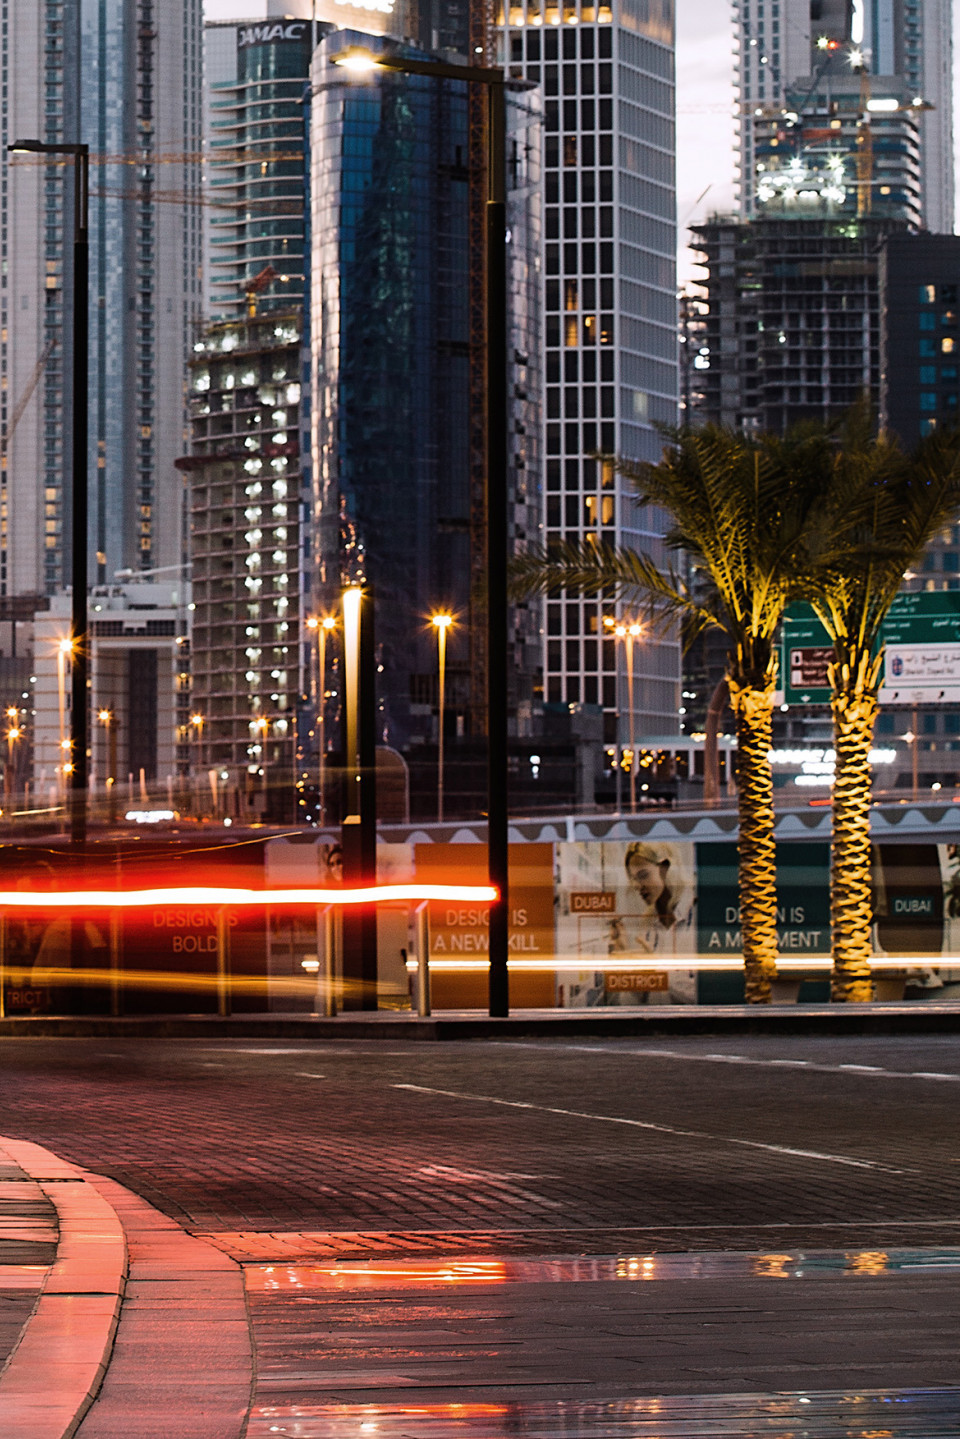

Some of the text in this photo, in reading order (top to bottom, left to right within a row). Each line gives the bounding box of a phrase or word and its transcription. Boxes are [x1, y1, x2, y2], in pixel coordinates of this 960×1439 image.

[574, 895, 612, 910] DUBAI
[894, 899, 931, 913] DUBAI
[446, 909, 527, 926] DESI IS
[791, 907, 804, 923] IS
[172, 935, 219, 952] BOLD
[433, 934, 539, 951] A NEW KILL
[708, 931, 821, 948] A MMENT
[608, 974, 666, 989] DISTRICT
